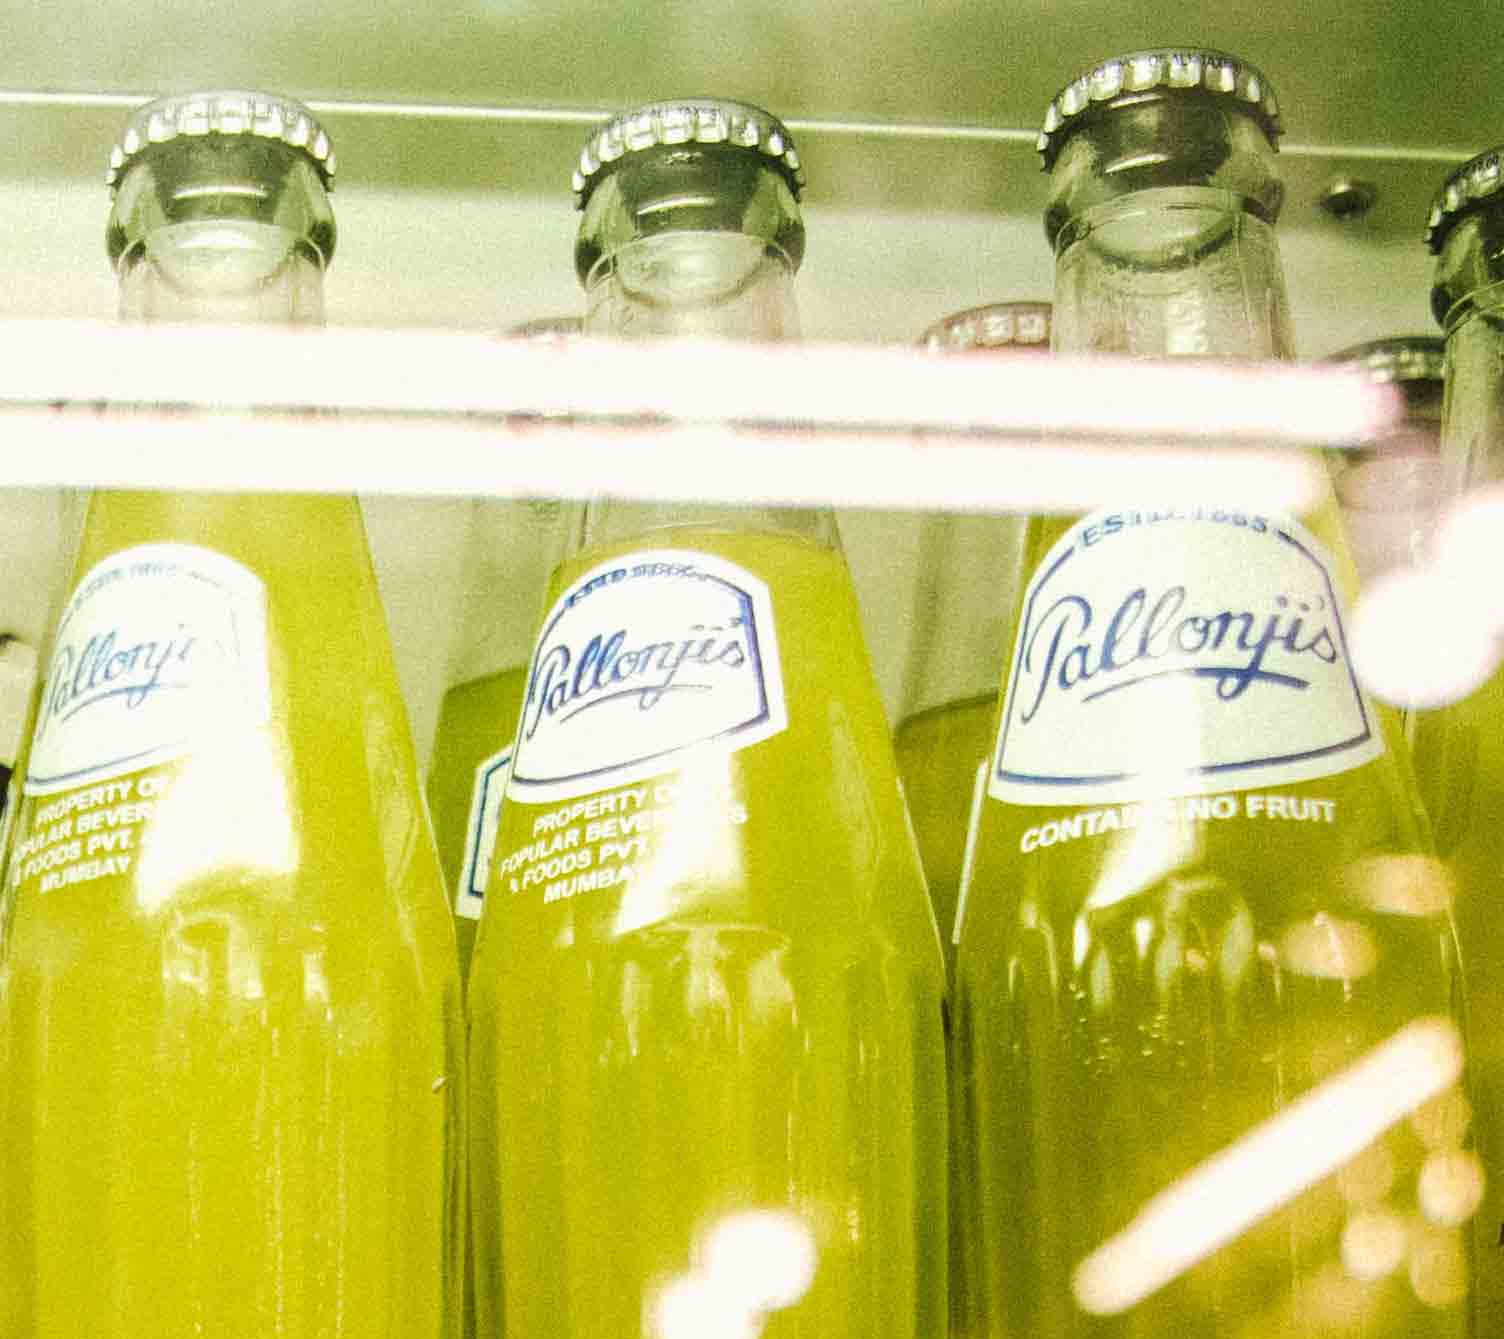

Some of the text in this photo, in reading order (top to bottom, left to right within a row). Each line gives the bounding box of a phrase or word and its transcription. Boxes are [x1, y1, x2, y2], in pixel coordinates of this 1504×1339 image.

[527, 616, 747, 742] Pallonji's
[1021, 585, 1337, 725] Pallonji's
[532, 789, 647, 838] PROPERTY
[1187, 796, 1239, 822] NO
[1245, 795, 1336, 823] FRUIT
[499, 826, 580, 882] POPULAR
[521, 847, 592, 891] FOODS
[543, 862, 635, 905] MUMBA
